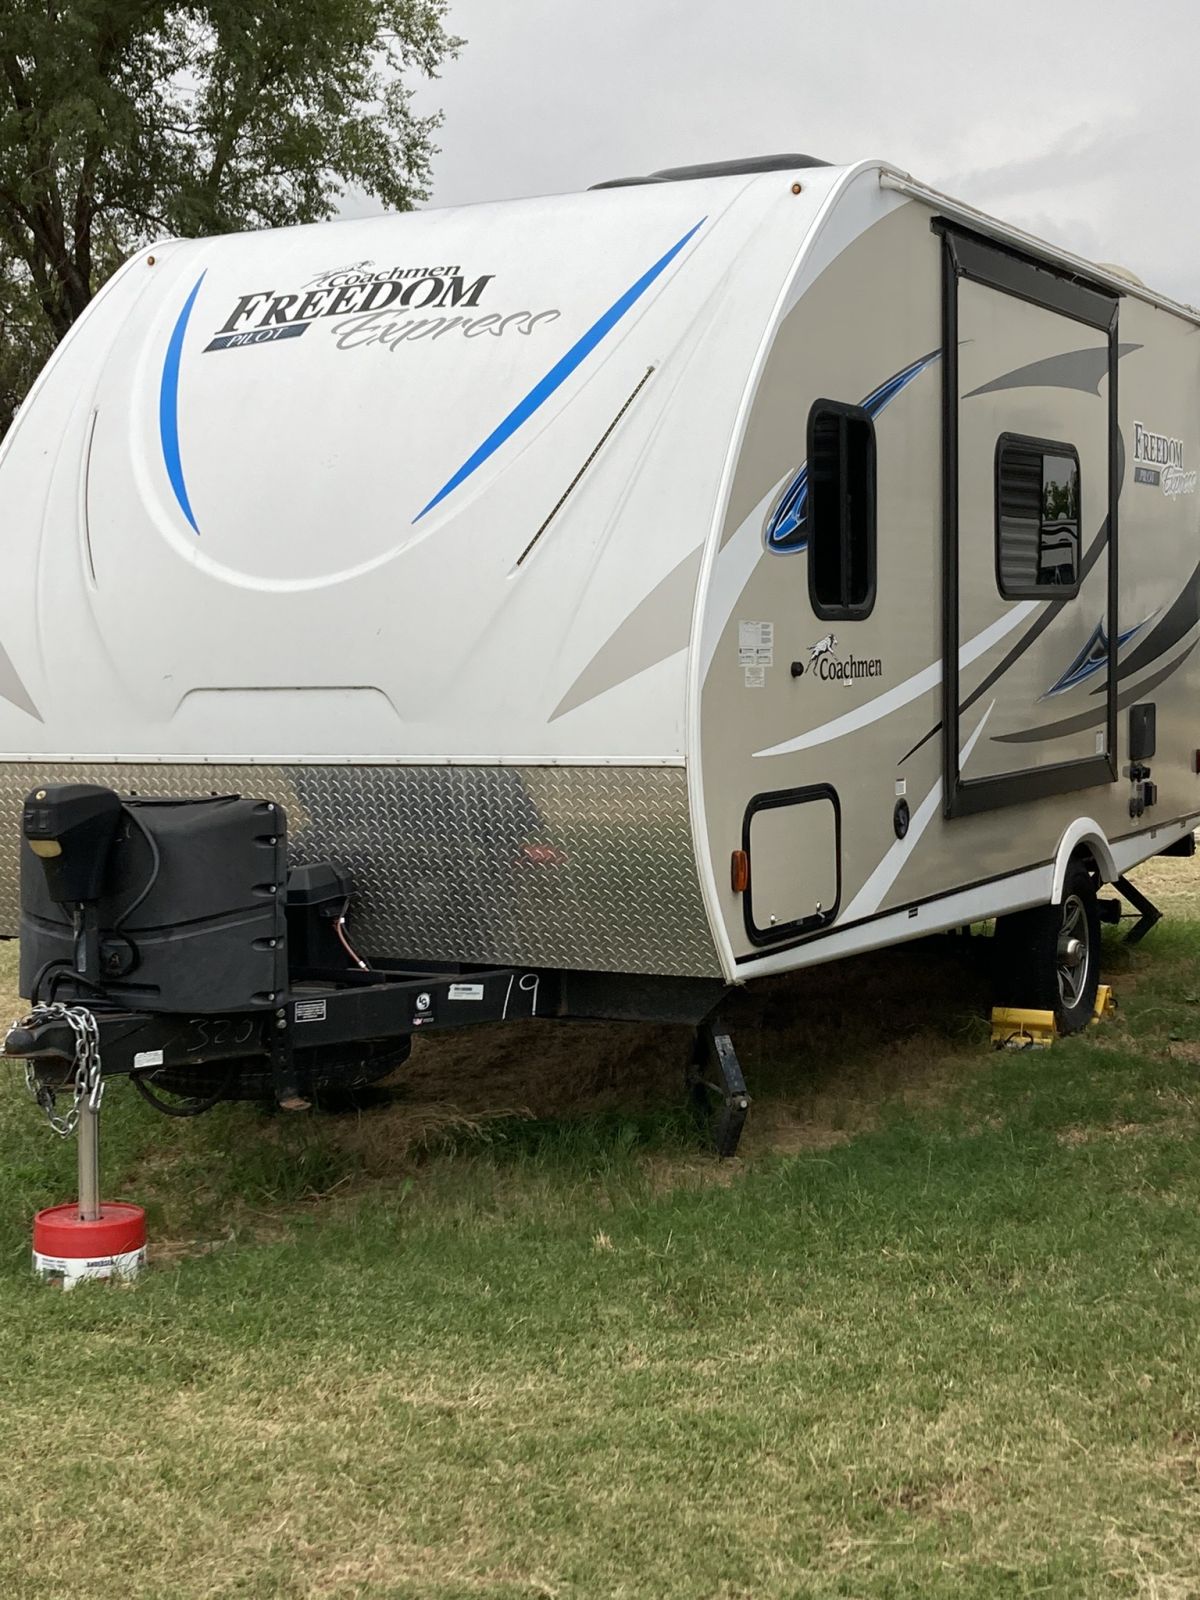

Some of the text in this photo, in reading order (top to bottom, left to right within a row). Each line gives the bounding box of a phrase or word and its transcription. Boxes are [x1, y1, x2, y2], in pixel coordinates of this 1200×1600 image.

[329, 265, 461, 289] Coachmen
[214, 274, 496, 335] FREEDOM
[225, 326, 289, 349] PILOT
[330, 308, 561, 353] Express
[1133, 422, 1183, 469] FREEDOM
[819, 655, 882, 681] Coachmen
[502, 973, 540, 1021] 19
